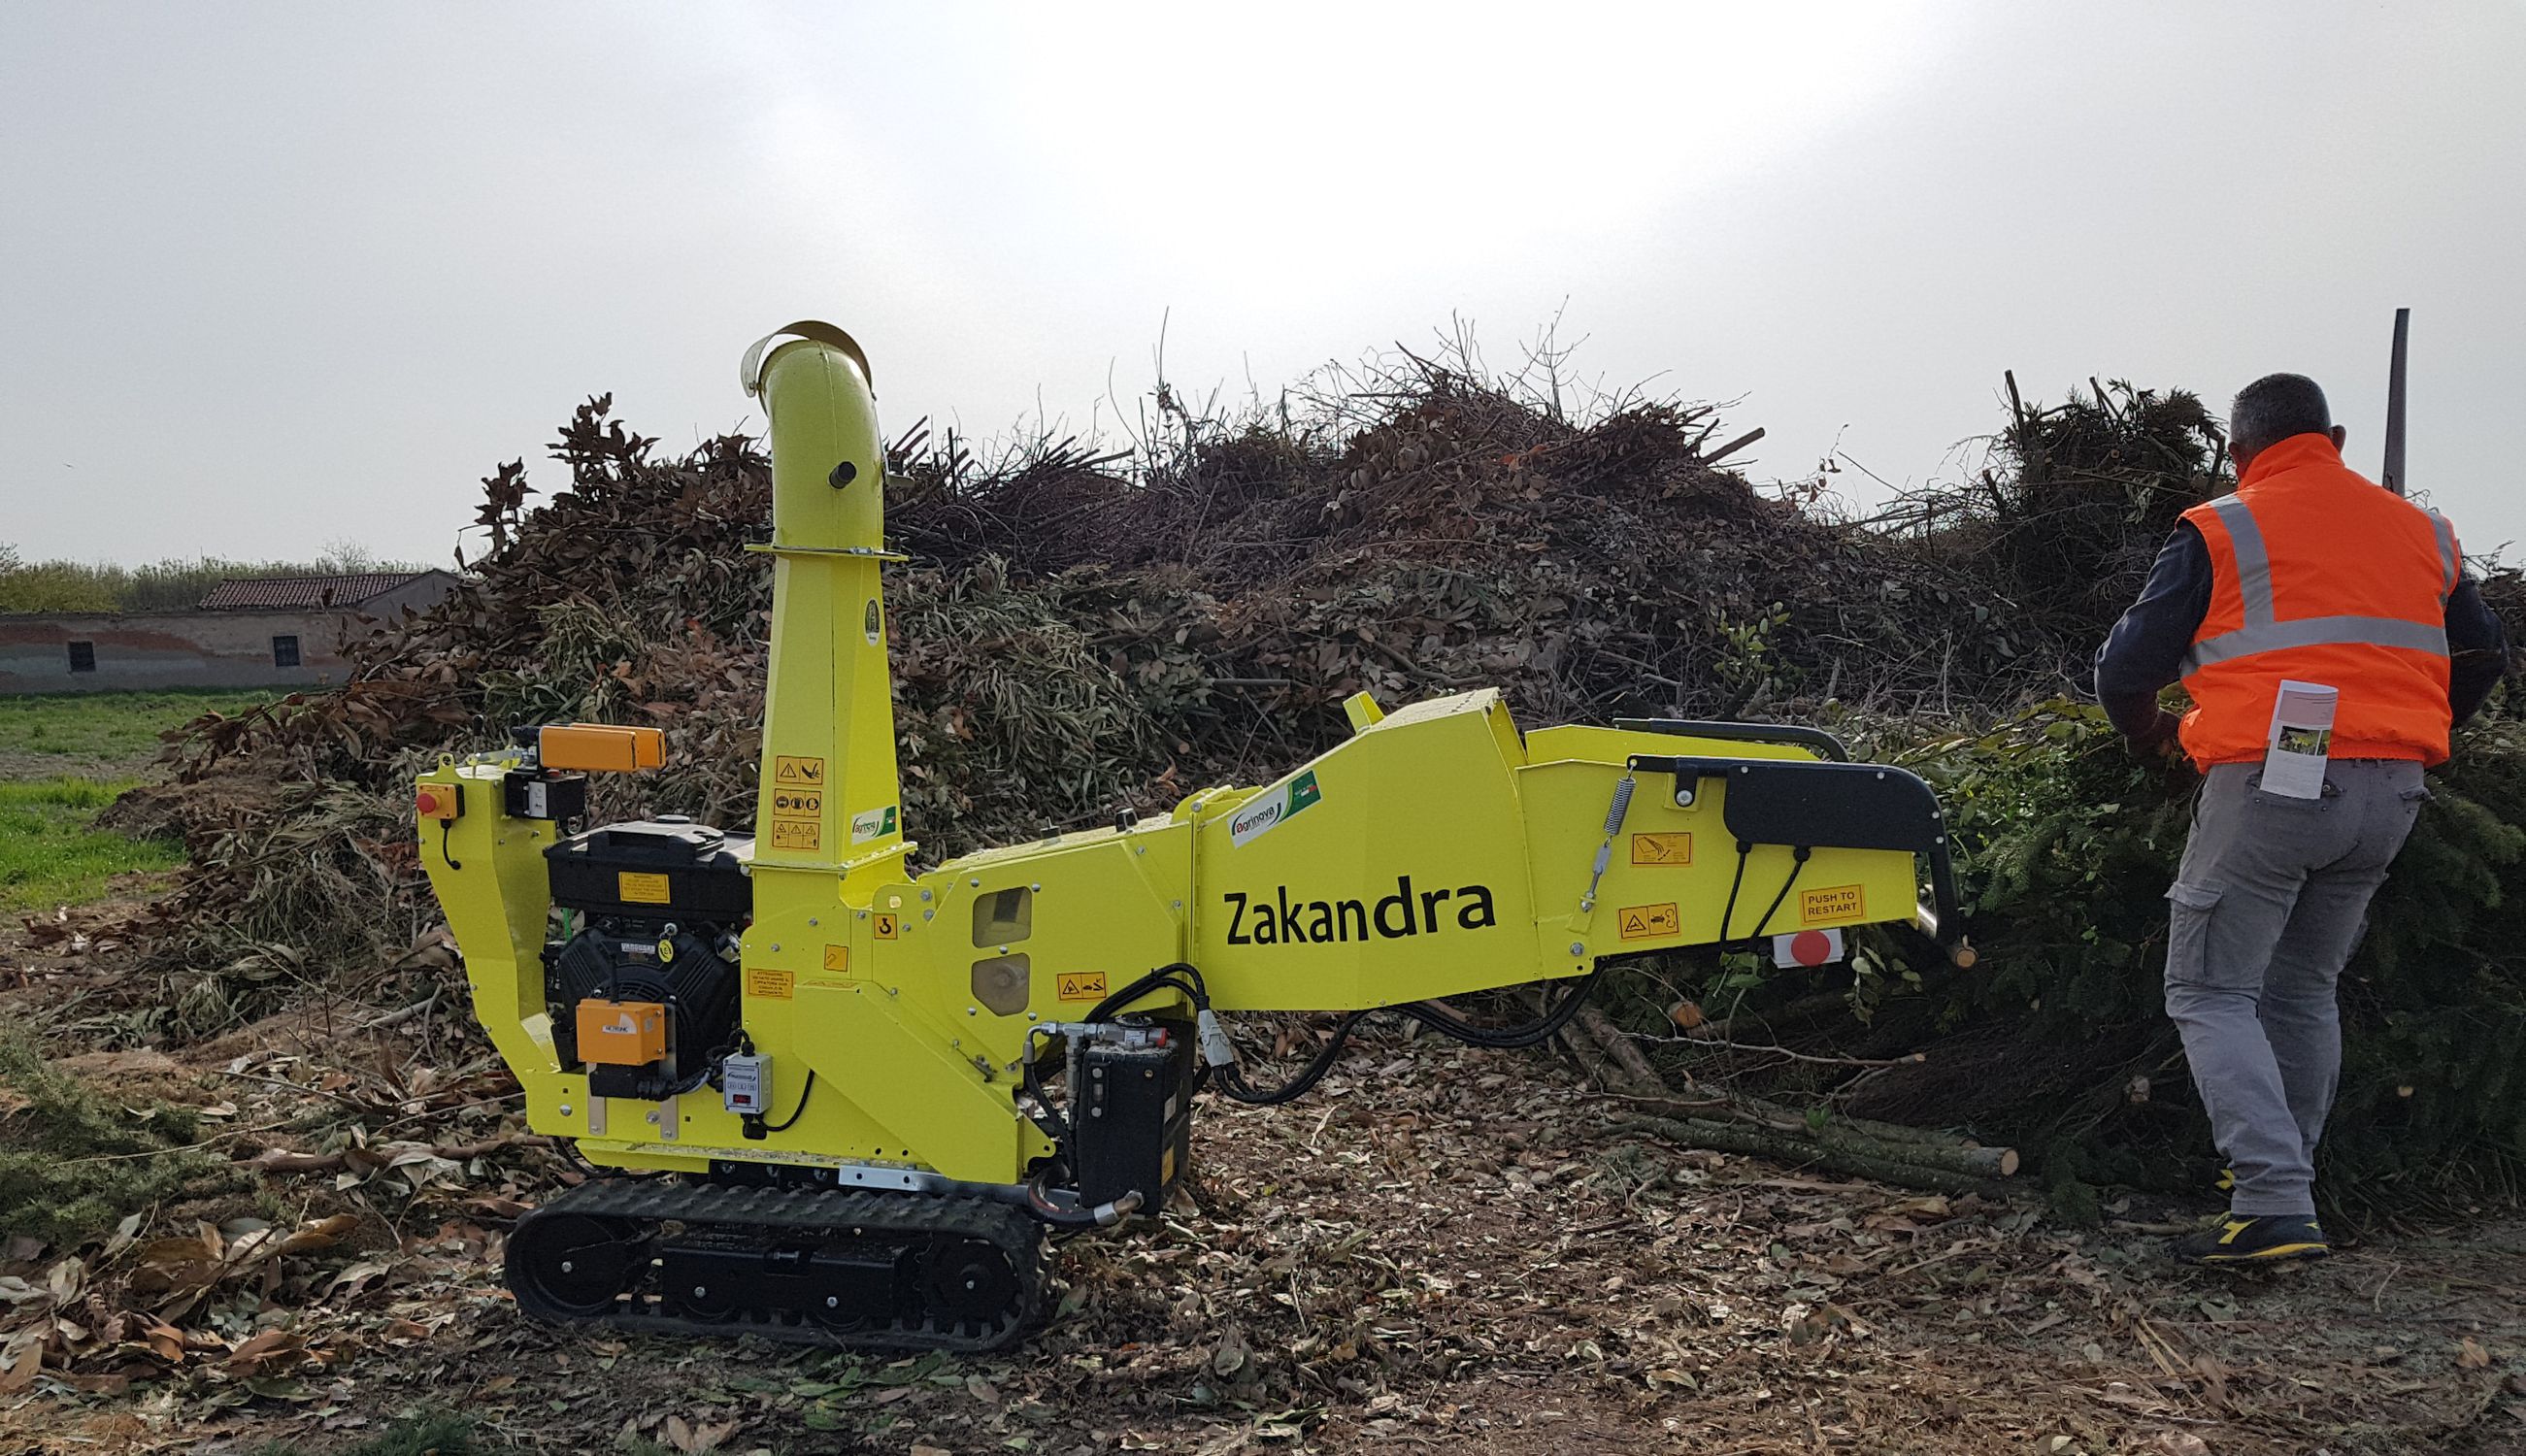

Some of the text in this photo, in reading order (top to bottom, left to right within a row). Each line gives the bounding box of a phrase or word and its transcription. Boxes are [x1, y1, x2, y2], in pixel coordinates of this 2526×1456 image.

[1236, 806, 1275, 833] agrinova
[1809, 894, 1837, 904] PUSH
[1224, 875, 1496, 945] Zakandra
[1809, 903, 1856, 915] RESTART
